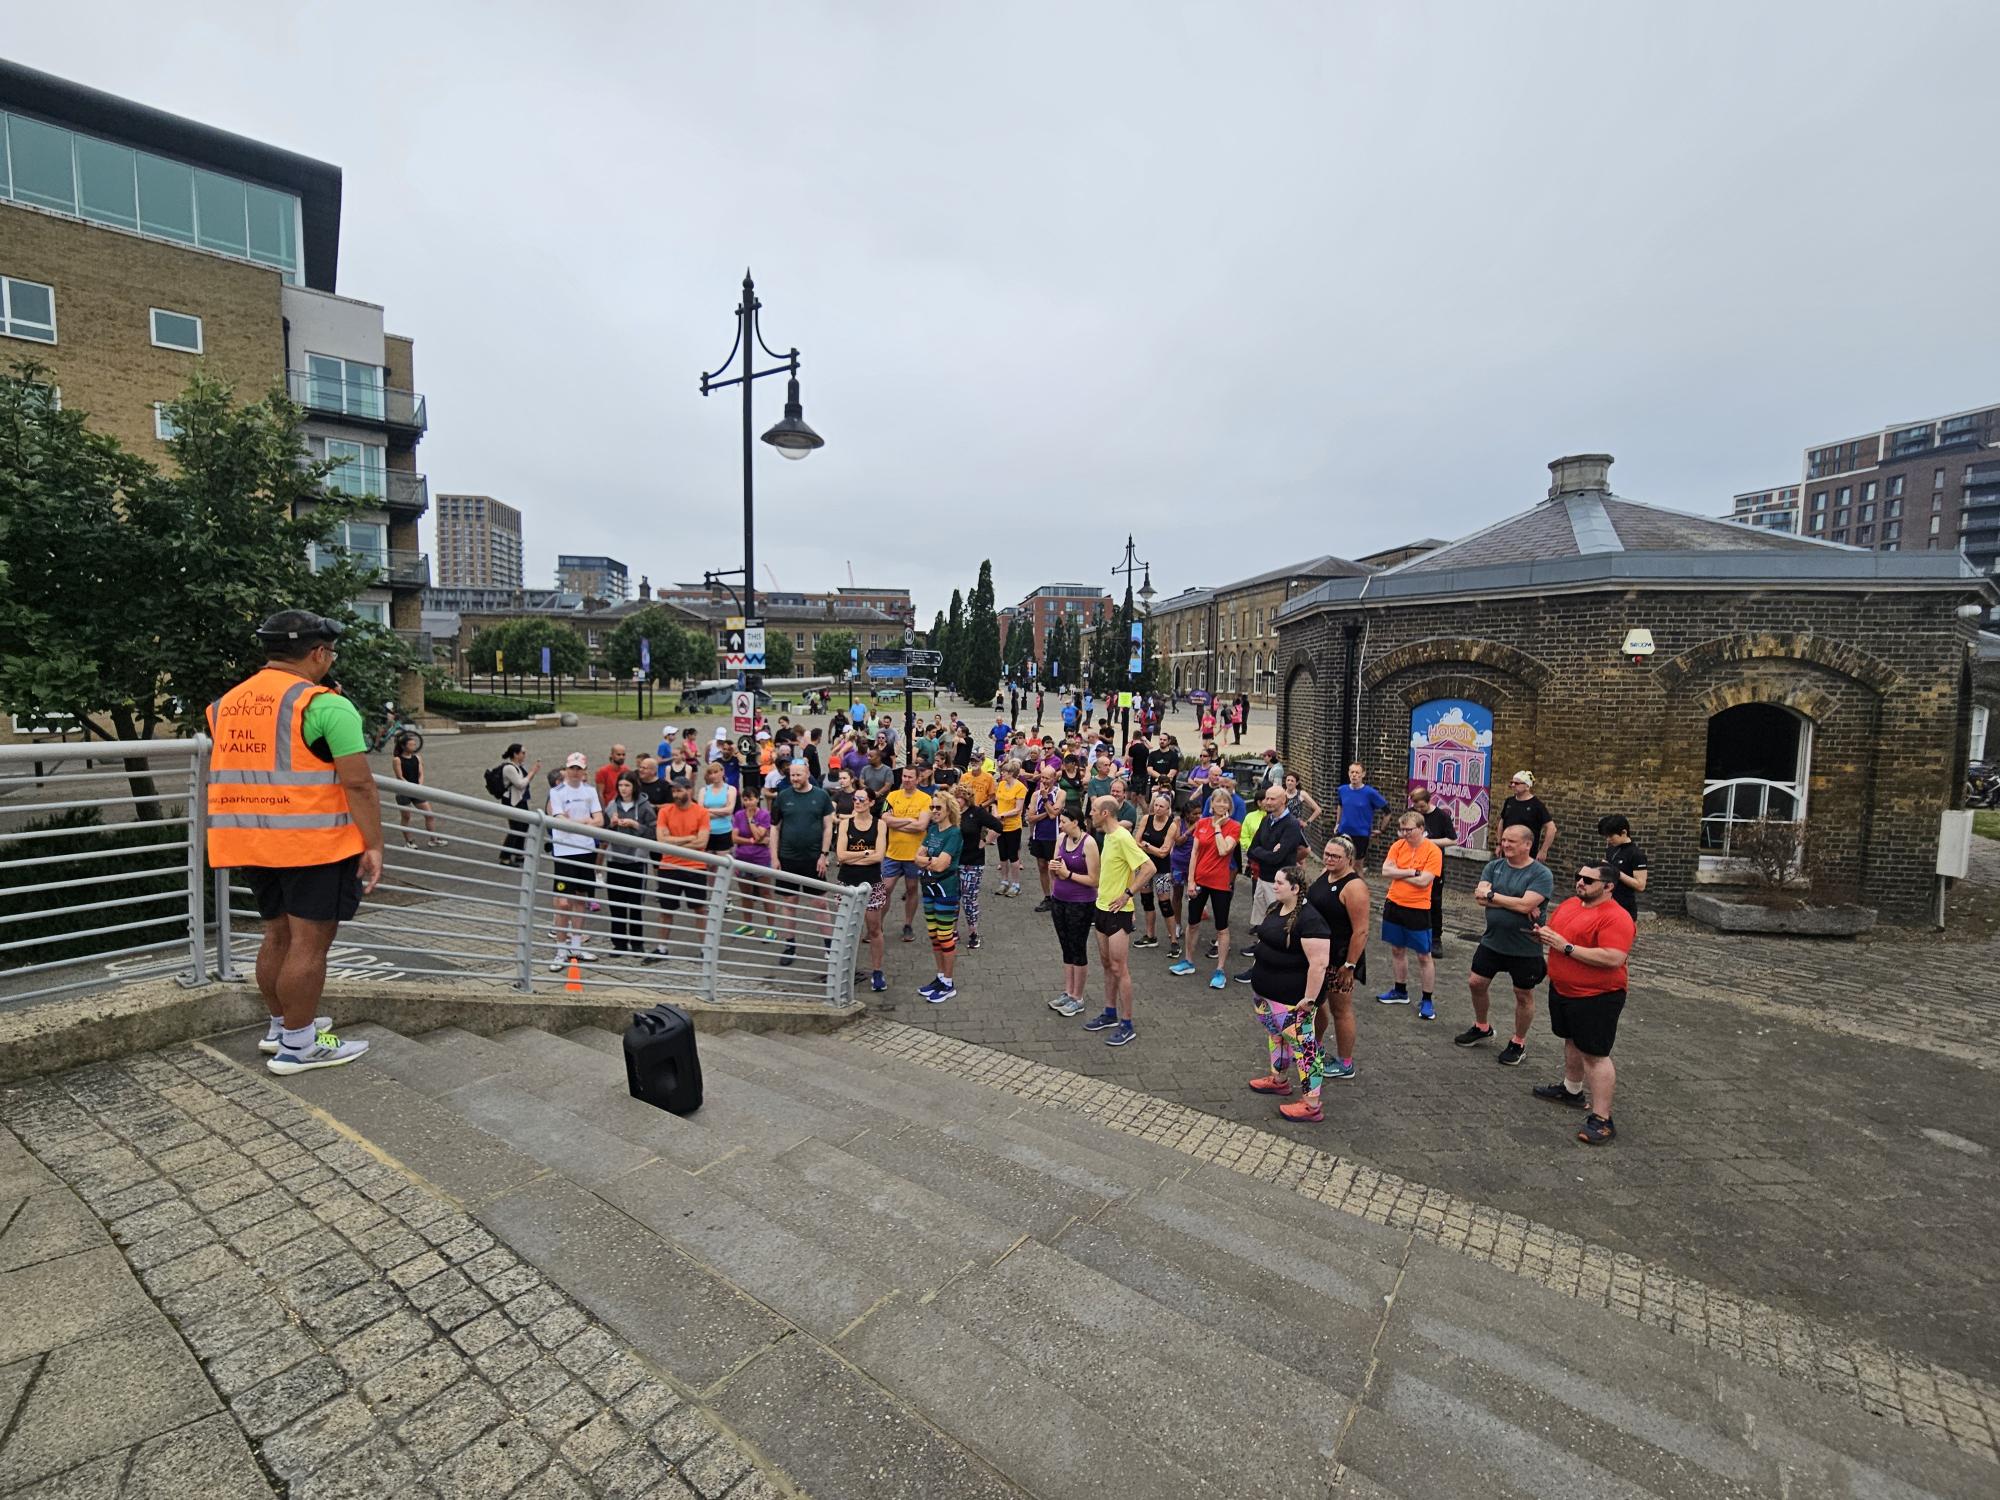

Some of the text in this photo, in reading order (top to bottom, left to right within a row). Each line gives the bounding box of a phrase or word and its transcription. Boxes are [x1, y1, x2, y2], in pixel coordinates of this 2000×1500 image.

[746, 632, 762, 641] THIS
[747, 641, 762, 649] WAY
[221, 699, 273, 717] parkrun
[228, 729, 255, 740] TAIL
[1427, 724, 1472, 740] HOUSE
[219, 742, 267, 753] WALKER
